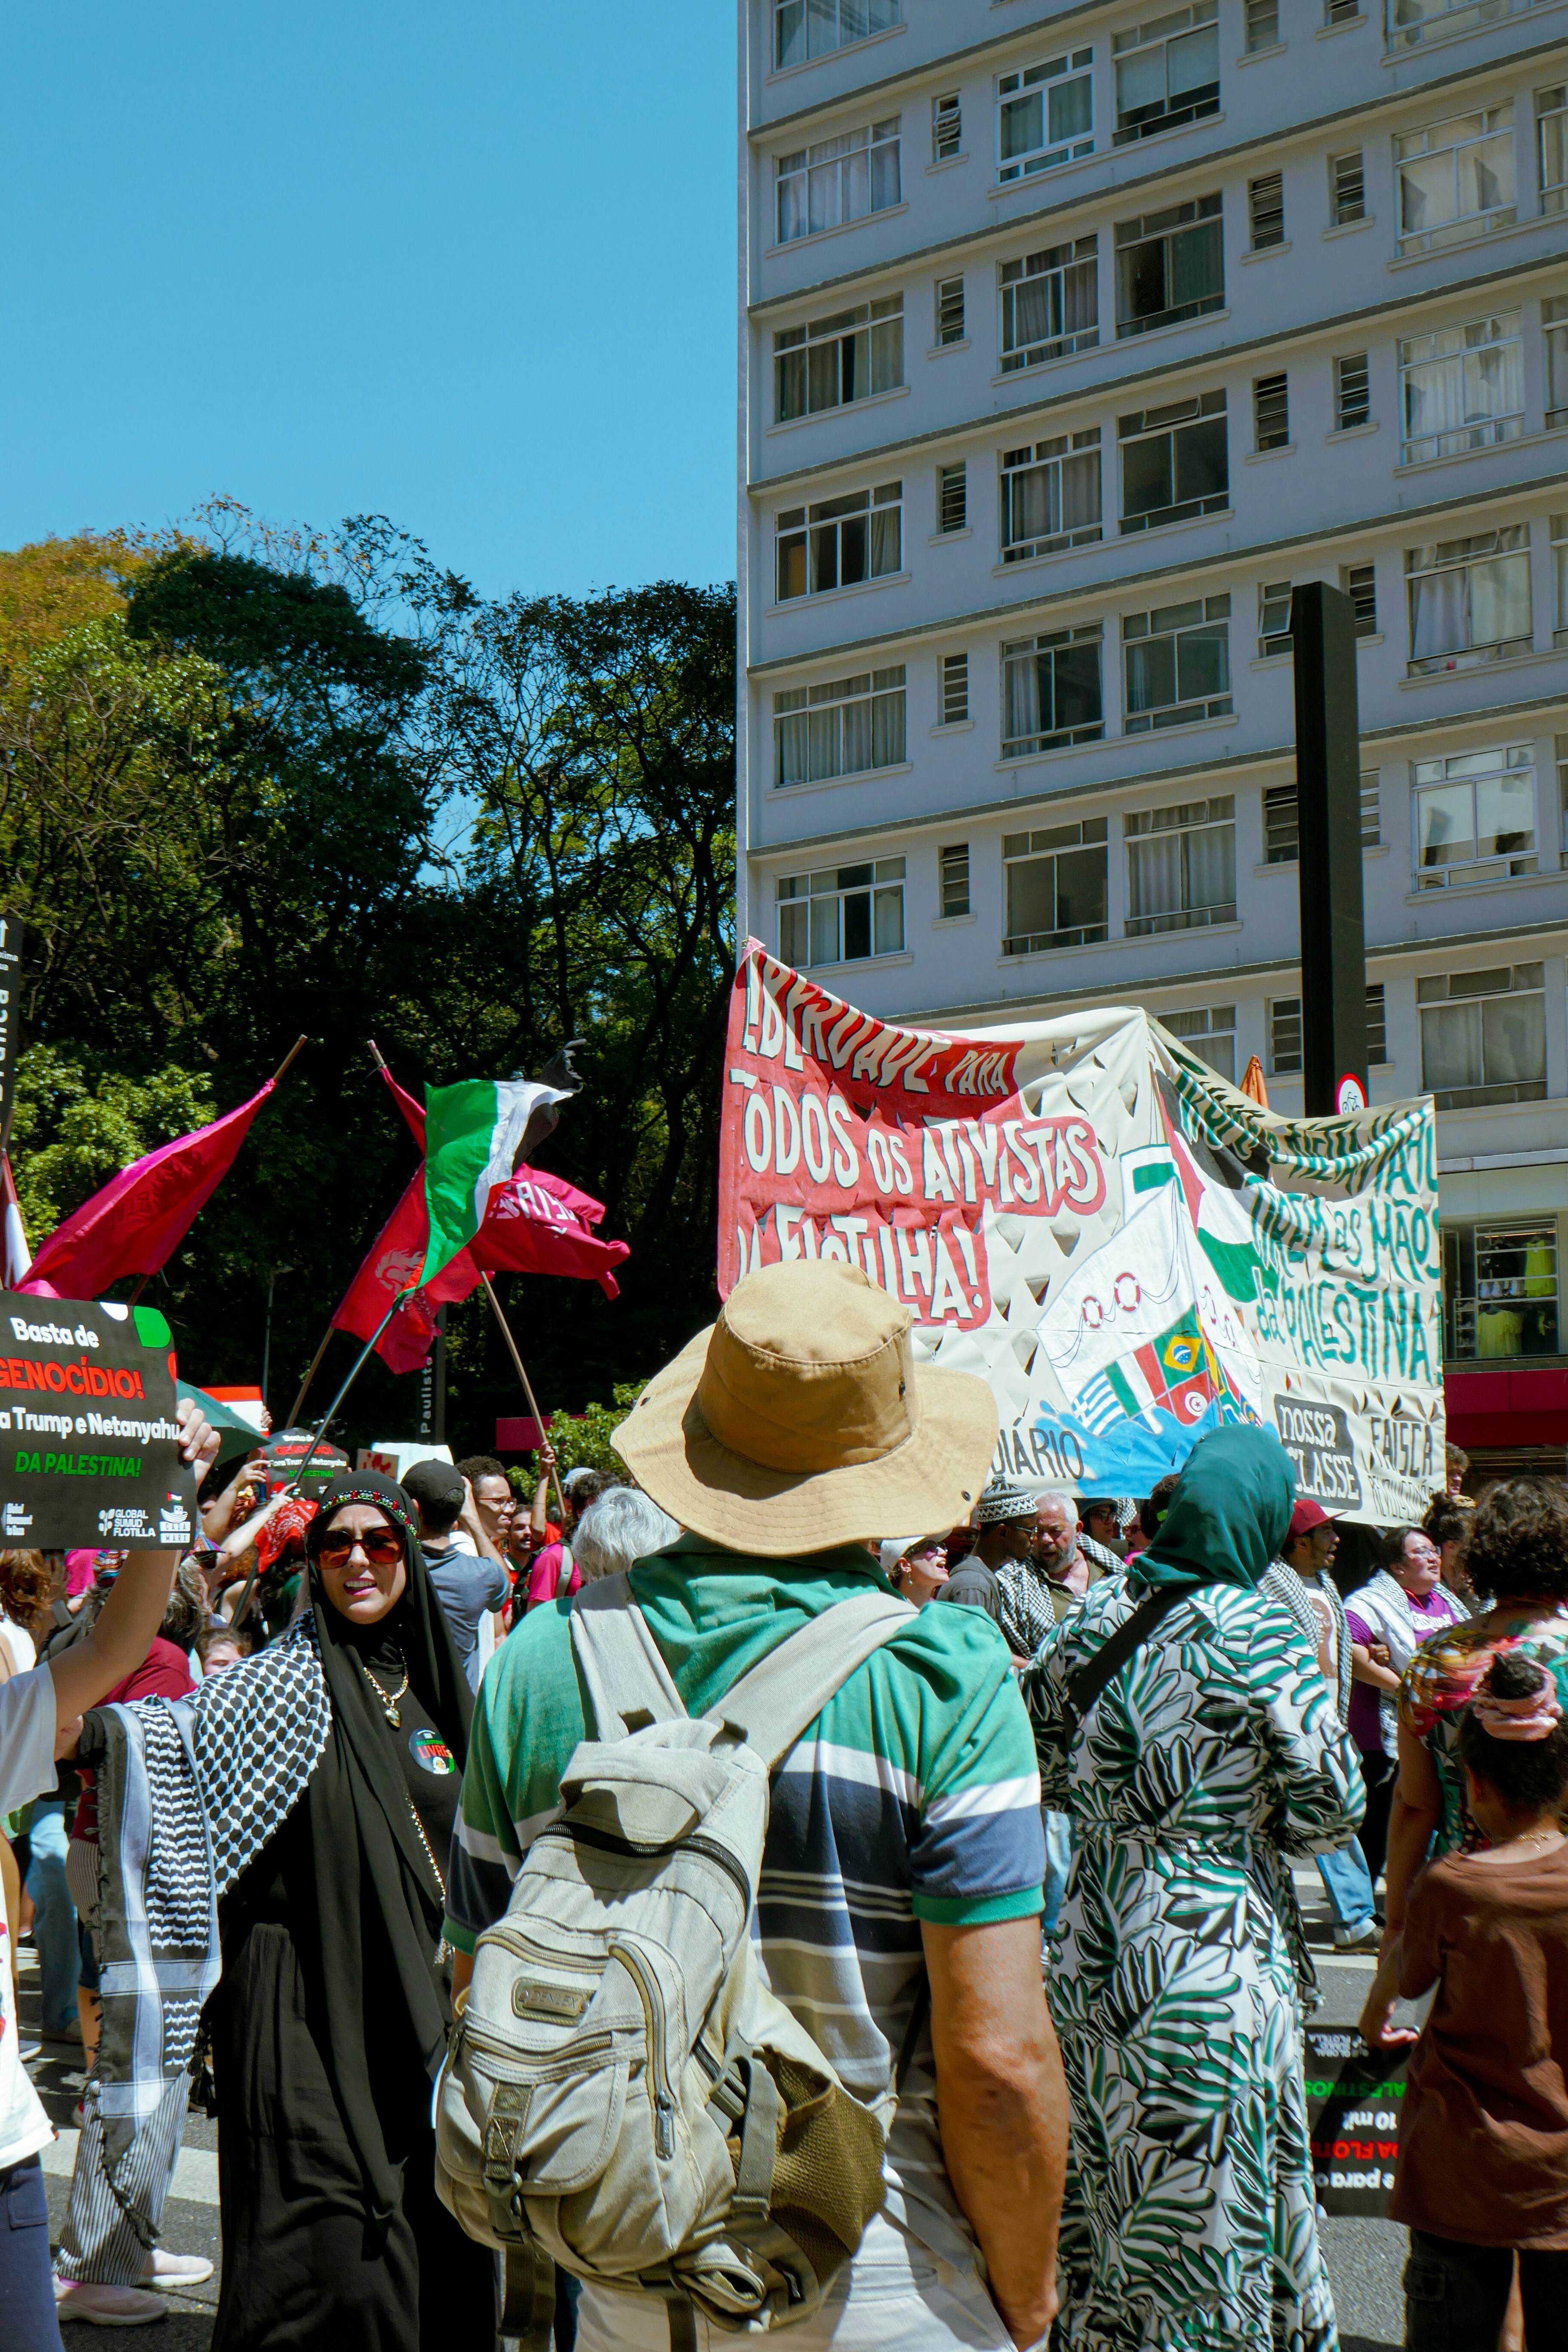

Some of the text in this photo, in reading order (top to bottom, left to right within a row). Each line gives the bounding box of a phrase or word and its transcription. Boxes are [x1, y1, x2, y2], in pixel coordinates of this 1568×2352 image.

[944, 1050, 1010, 1096] PARA
[730, 1069, 1099, 1208] TODOS OS ATIVISTAS
[10, 1317, 100, 1348] Basta de
[0, 1355, 145, 1400] GENOCÍDIO!
[12, 1406, 73, 1439] Trump
[75, 1417, 87, 1434] e
[86, 1412, 181, 1445] Netanyahu
[1280, 1404, 1336, 1448] nossa
[15, 1450, 142, 1478] DA PALESTINA!
[114, 1518, 143, 1528] SUMUD
[115, 1509, 149, 1519] GLOBAL
[113, 1527, 156, 1537] FLOTILLA
[417, 1744, 450, 1759] LIVRE
[1304, 2079, 1407, 2098] ALESTINOS
[1375, 2111, 1398, 2131] 10
[1329, 2166, 1382, 2190] para
